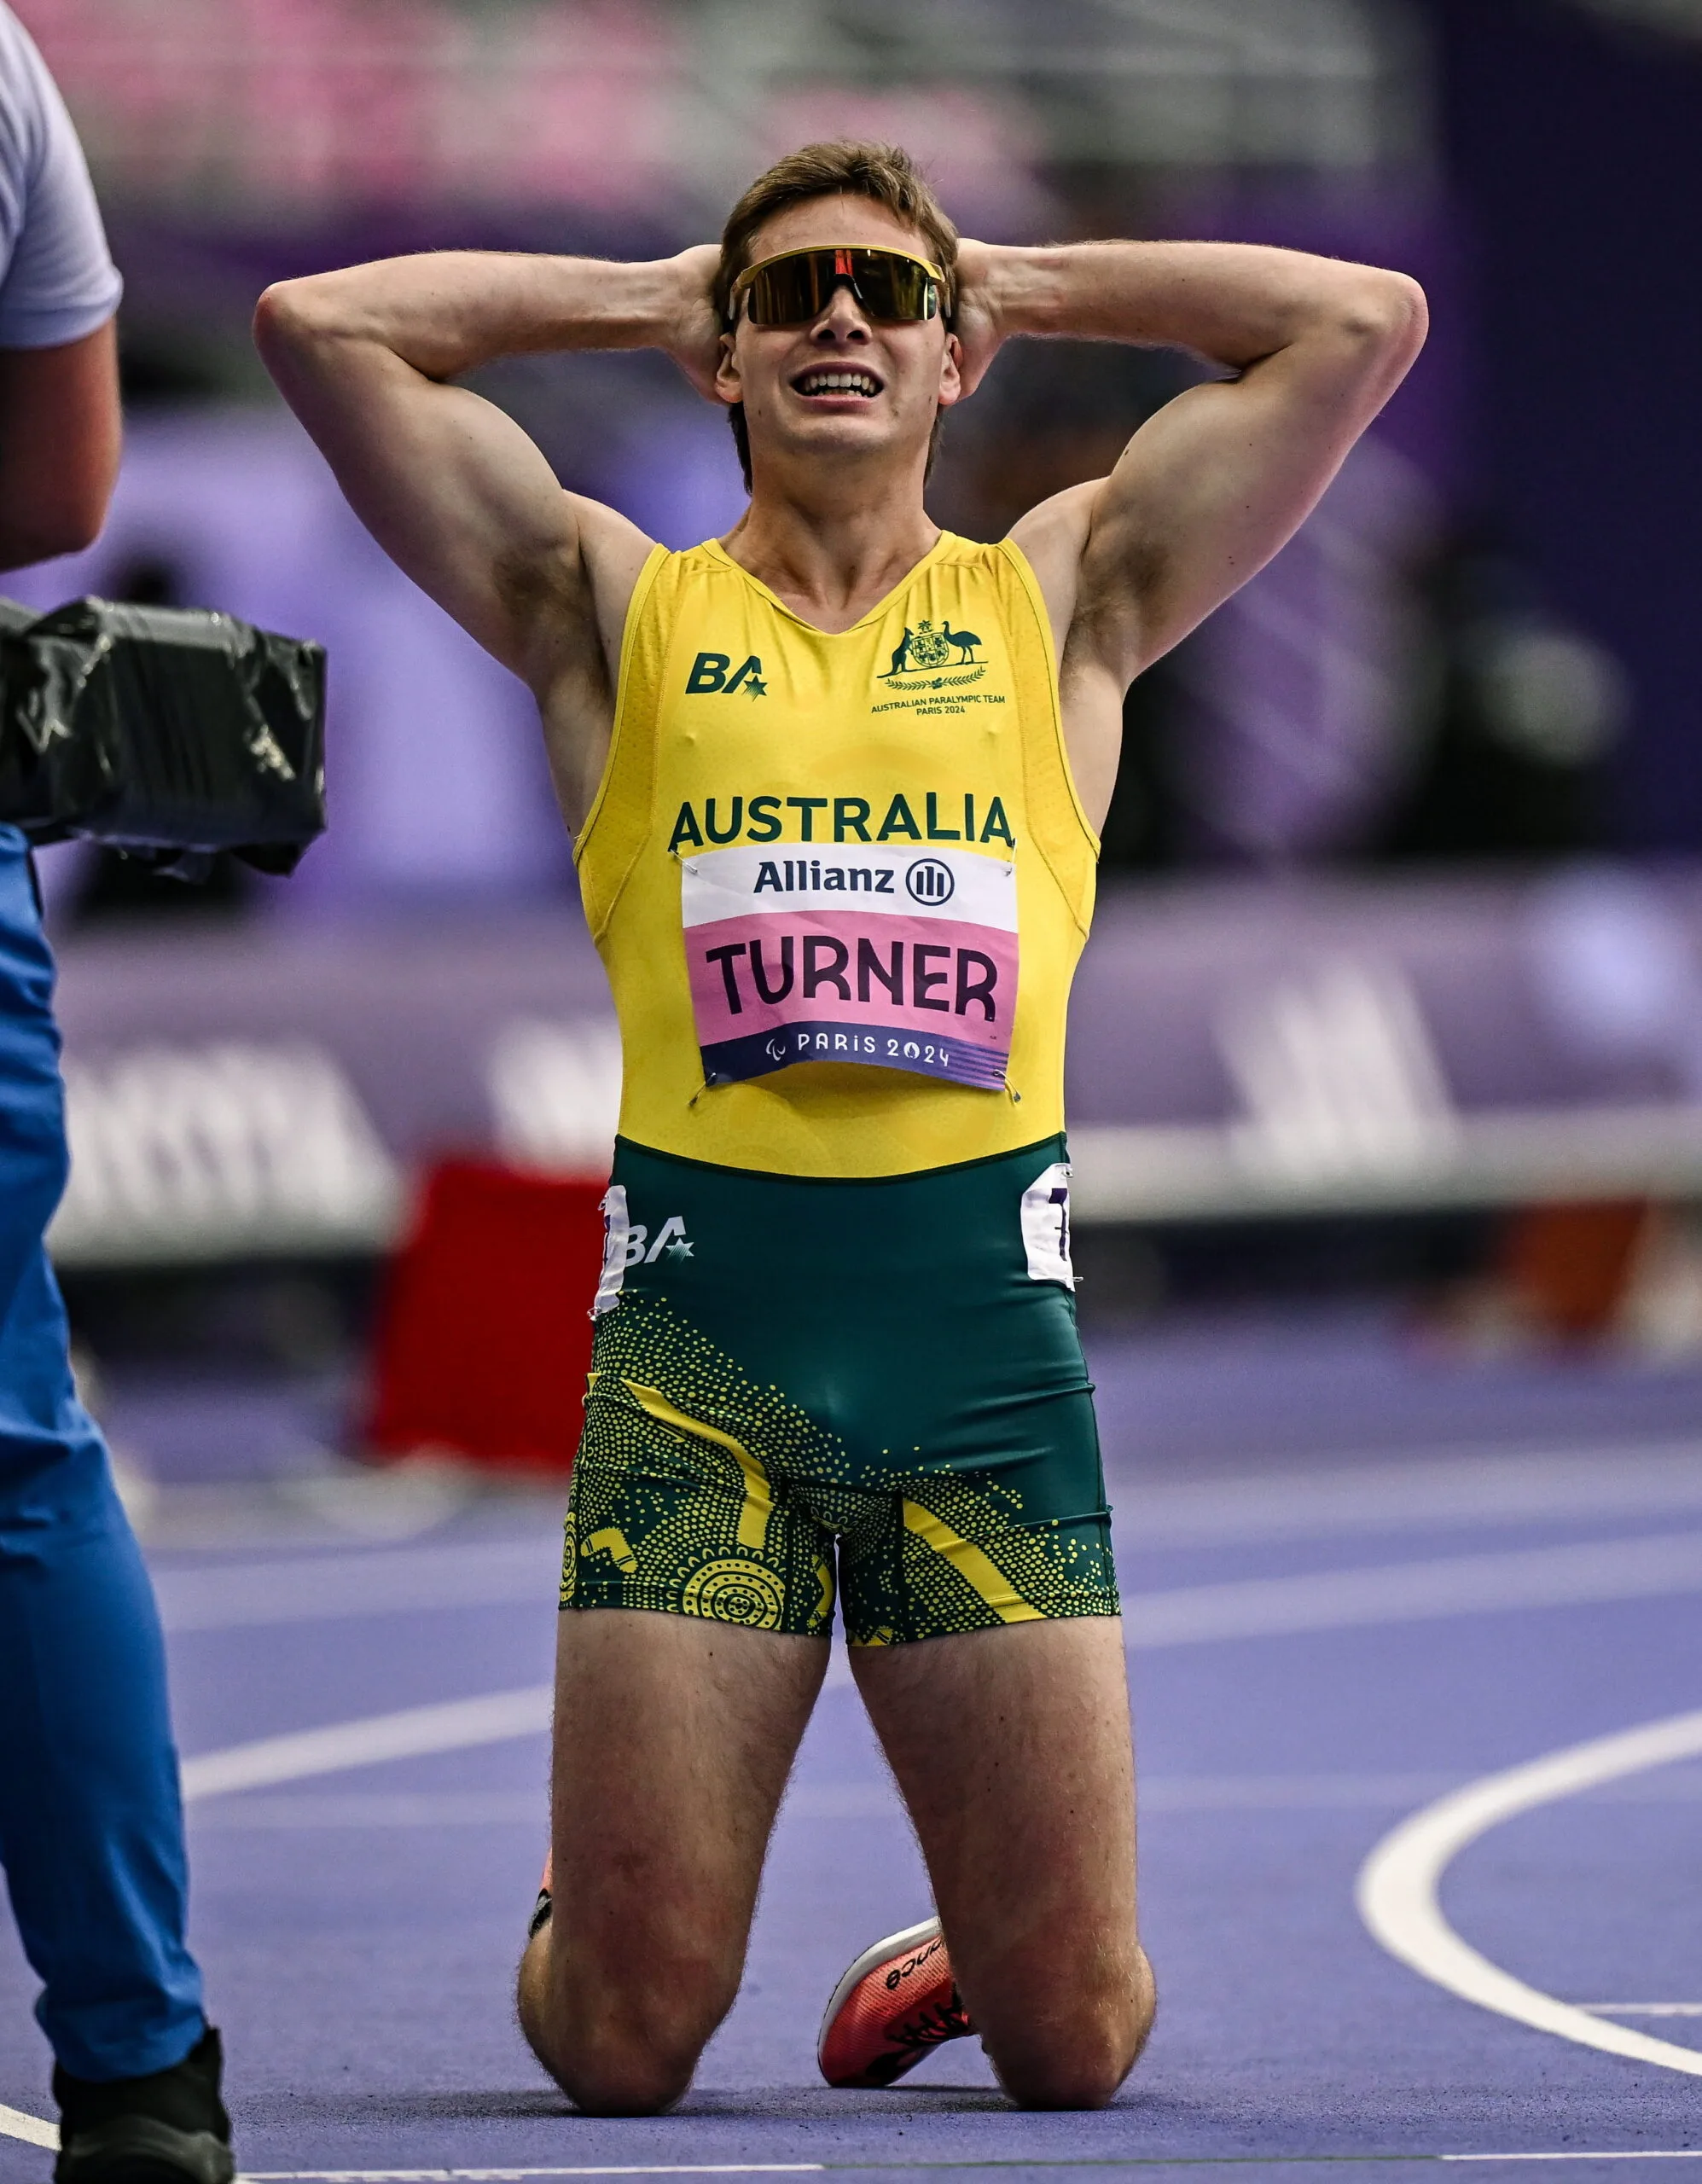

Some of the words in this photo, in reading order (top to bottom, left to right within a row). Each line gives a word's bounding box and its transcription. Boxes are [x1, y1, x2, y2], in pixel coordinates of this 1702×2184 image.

[685, 652, 764, 695] BA
[871, 698, 927, 714] AUSTRALIAN
[929, 694, 982, 706] PARALYMPIC
[983, 694, 1005, 704] TEAM
[916, 706, 942, 716] PARIS
[944, 706, 965, 714] 2024
[668, 792, 1015, 853] AUSTRALIA
[753, 860, 895, 894] Allianz
[706, 935, 997, 1022] TURNER
[798, 1032, 876, 1052] PARIS
[887, 1037, 950, 1067] 2024
